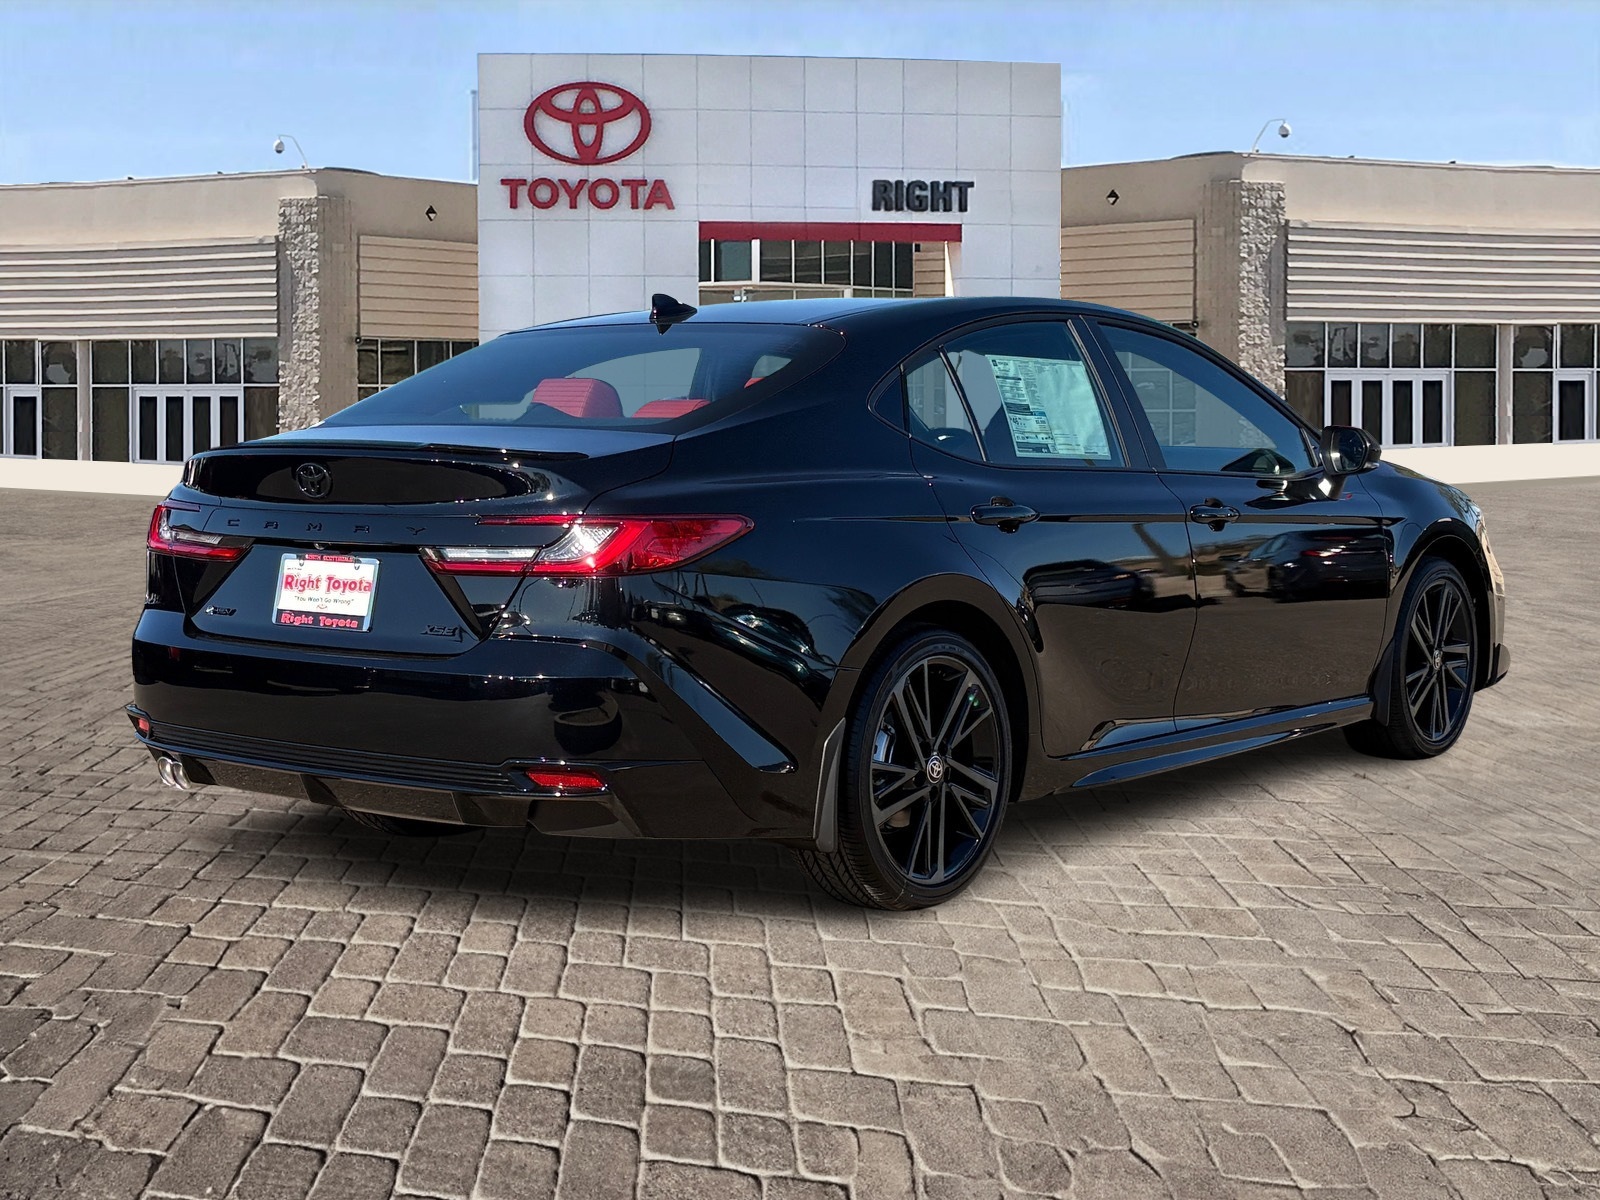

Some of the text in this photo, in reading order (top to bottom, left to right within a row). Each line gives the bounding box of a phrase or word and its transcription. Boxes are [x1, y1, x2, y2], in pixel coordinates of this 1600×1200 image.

[501, 179, 676, 210] TOYOTA
[871, 179, 976, 213] RIGHT
[227, 519, 426, 535] CAMRY
[284, 573, 372, 594] Right Toyota
[281, 611, 359, 628] Right Toyota
